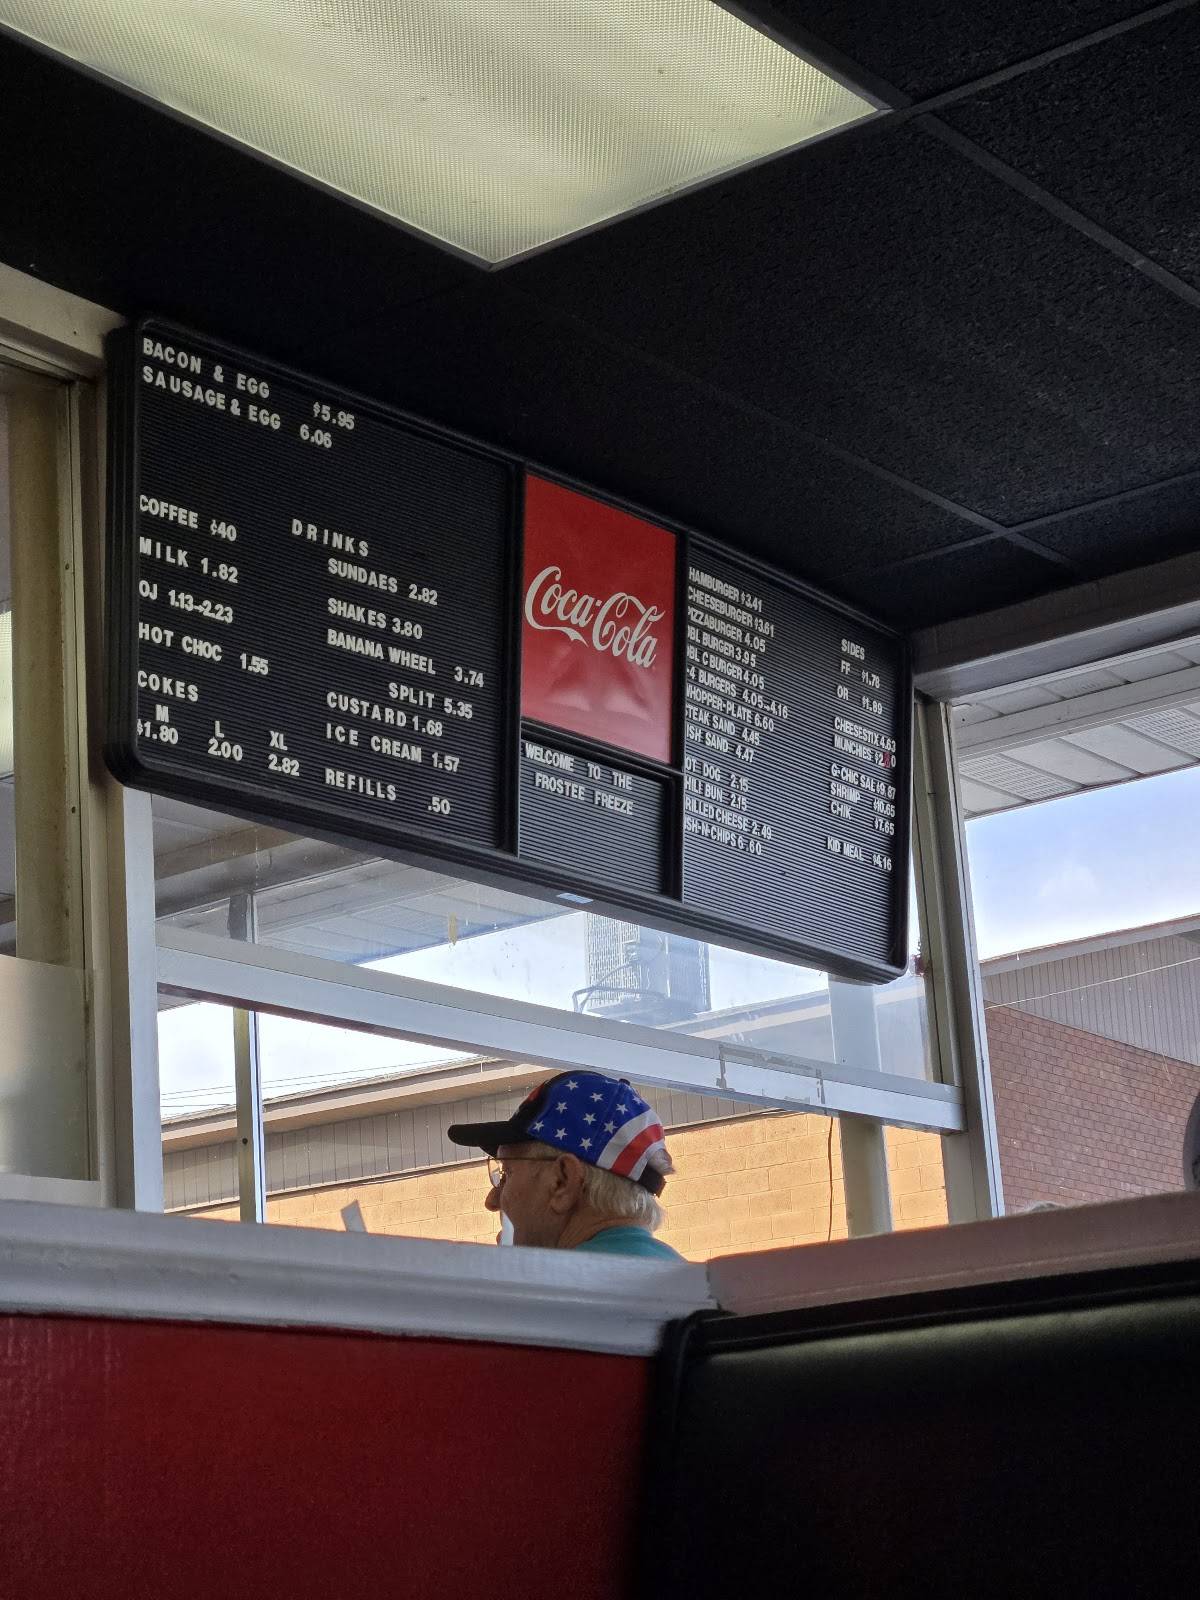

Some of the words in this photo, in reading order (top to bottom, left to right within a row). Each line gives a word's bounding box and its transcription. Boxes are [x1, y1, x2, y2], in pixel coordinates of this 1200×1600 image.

[142, 338, 201, 374] BACON
[213, 365, 224, 383] &
[236, 373, 270, 398] EGG
[142, 365, 226, 410] SAUSAGE
[230, 399, 241, 416] &
[249, 405, 281, 430] EGG
[313, 402, 355, 430] $5.95
[139, 494, 199, 529] COFFEE
[291, 519, 369, 557] DRINKS
[139, 536, 189, 567] MILK
[201, 558, 238, 584] 1.82
[138, 580, 158, 600] OJ
[327, 557, 398, 593] SUNDAES
[408, 583, 438, 606] 2.82
[688, 566, 740, 602] HAMBURGER
[327, 597, 386, 629] SHAKES
[391, 617, 423, 640] 3.80
[524, 565, 666, 668] Coca-Cola
[688, 585, 753, 628] CHEESEBURGER
[138, 622, 174, 647] HOT
[182, 636, 222, 661] CHOC
[240, 653, 269, 675] 1.55
[327, 628, 384, 660] BANANA
[388, 646, 436, 675] WHEEL
[454, 666, 484, 688] 3.74
[702, 631, 735, 658] BURGER
[744, 632, 766, 653] 4.05
[841, 638, 865, 660] SIDES
[137, 670, 198, 702] COKES
[698, 669, 737, 698] BURGERS
[709, 654, 743, 681] BURGER
[743, 670, 765, 690] 4.05
[155, 704, 169, 723] M
[326, 691, 407, 727] CUSTARD
[412, 715, 443, 737] 1.68
[388, 682, 434, 708] SPLIT
[443, 697, 473, 719] 5.35
[136, 719, 179, 745] $1.80
[214, 720, 225, 738] L
[269, 731, 288, 750] XL
[712, 715, 736, 736] SAND
[207, 737, 243, 761] 2.00
[326, 723, 359, 746] ICE
[370, 735, 422, 763] CREAM
[431, 752, 460, 773] 1.57
[705, 731, 729, 753] SAND
[268, 754, 300, 776] 2.82
[525, 742, 575, 772] WELCOME
[587, 762, 601, 780] TO
[612, 772, 633, 791] THE
[702, 763, 721, 781] DOG
[325, 768, 396, 801] REFILLS
[427, 796, 451, 815] .50
[535, 772, 585, 801] FROSTEE
[594, 790, 634, 815] FREEZE
[685, 796, 715, 819] RILLED
[704, 783, 723, 803] BUN
[830, 781, 861, 803] SHRIMP
[843, 842, 864, 861] MEAL
